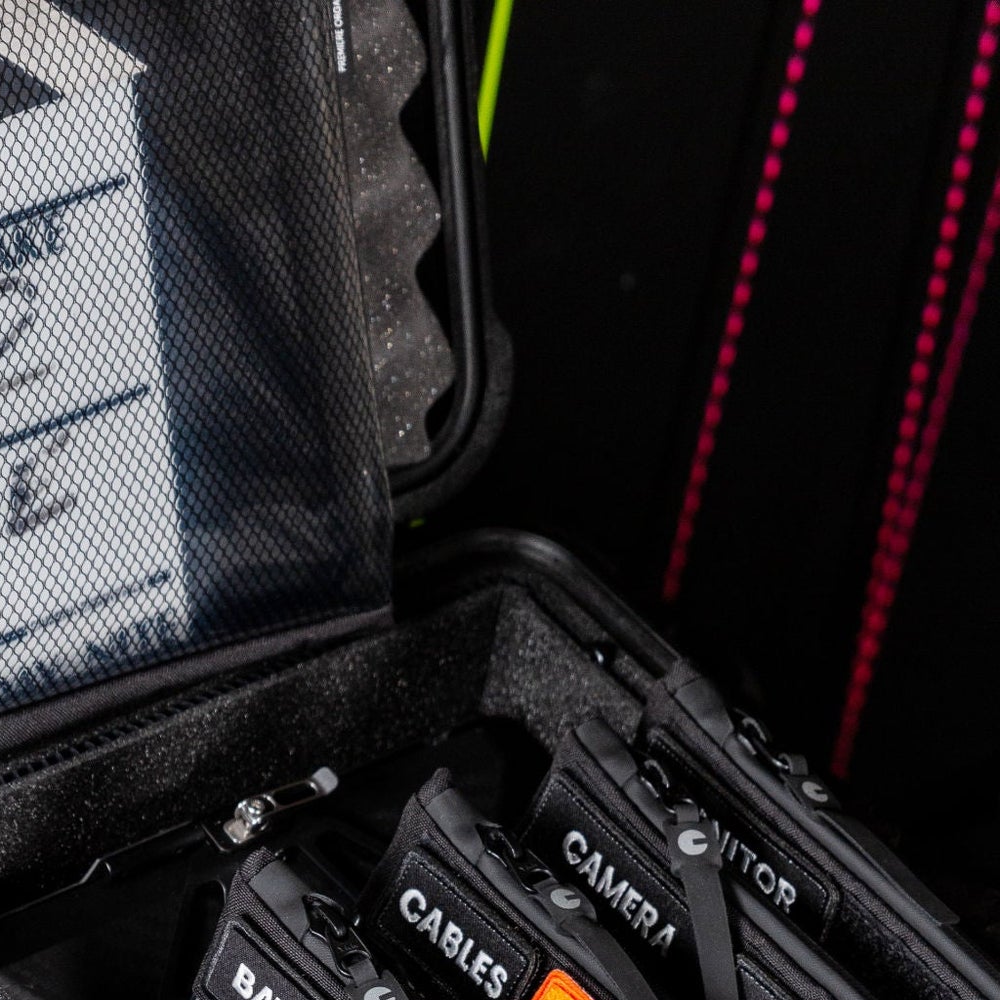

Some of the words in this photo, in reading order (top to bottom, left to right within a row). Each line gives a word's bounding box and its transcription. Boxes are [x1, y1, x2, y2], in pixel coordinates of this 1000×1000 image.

[334, 28, 347, 73] PREMIERE
[562, 829, 677, 960] CAMERA
[713, 819, 798, 915] NITOR
[399, 888, 509, 1000] CABLES
